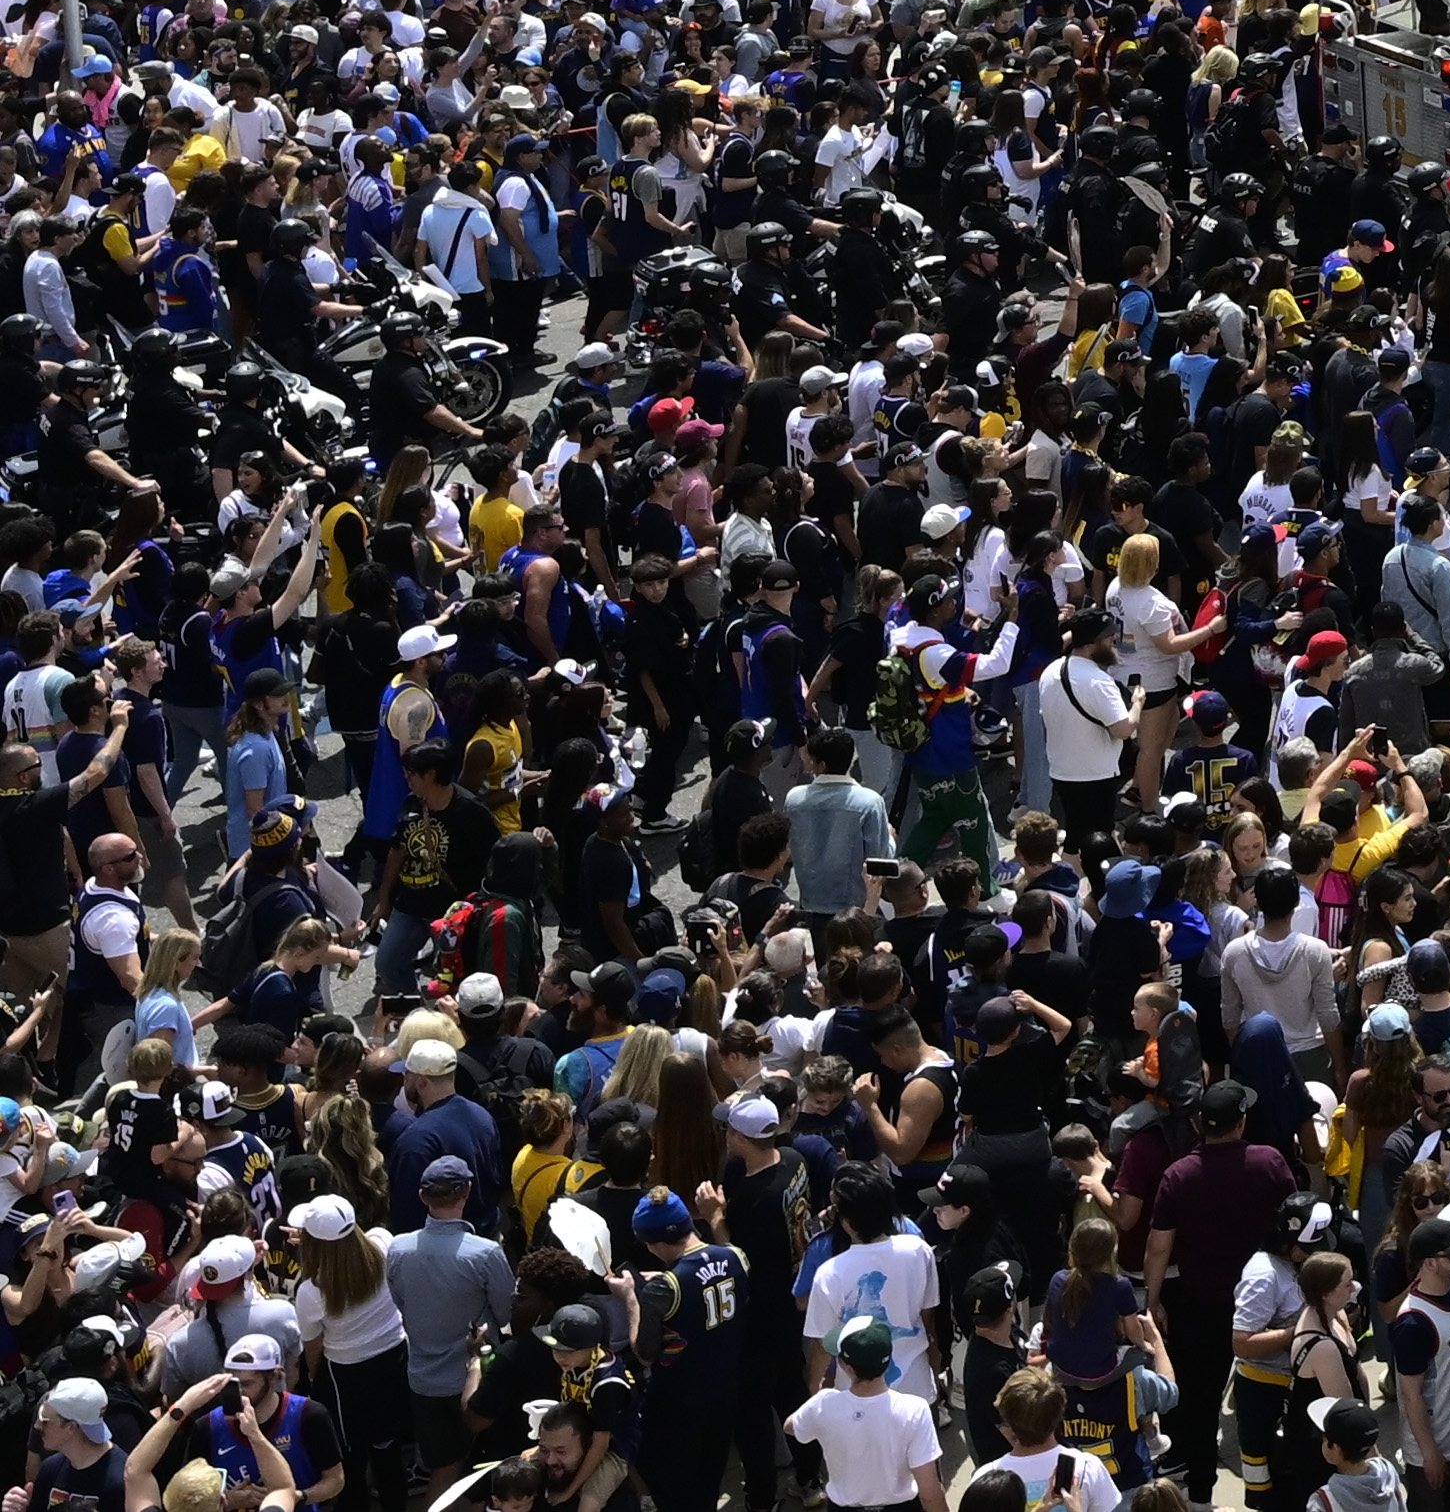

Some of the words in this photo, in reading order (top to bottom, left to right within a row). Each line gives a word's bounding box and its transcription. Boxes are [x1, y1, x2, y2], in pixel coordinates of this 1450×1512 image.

[1382, 92, 1407, 137] 15
[1246, 495, 1274, 516] MURRAY
[1185, 758, 1238, 803] 15
[114, 1122, 134, 1152] 15
[250, 1174, 283, 1224] 27
[695, 1260, 729, 1287] JOKIC
[703, 1276, 736, 1331] 15
[1064, 1419, 1115, 1439] NTHONY
